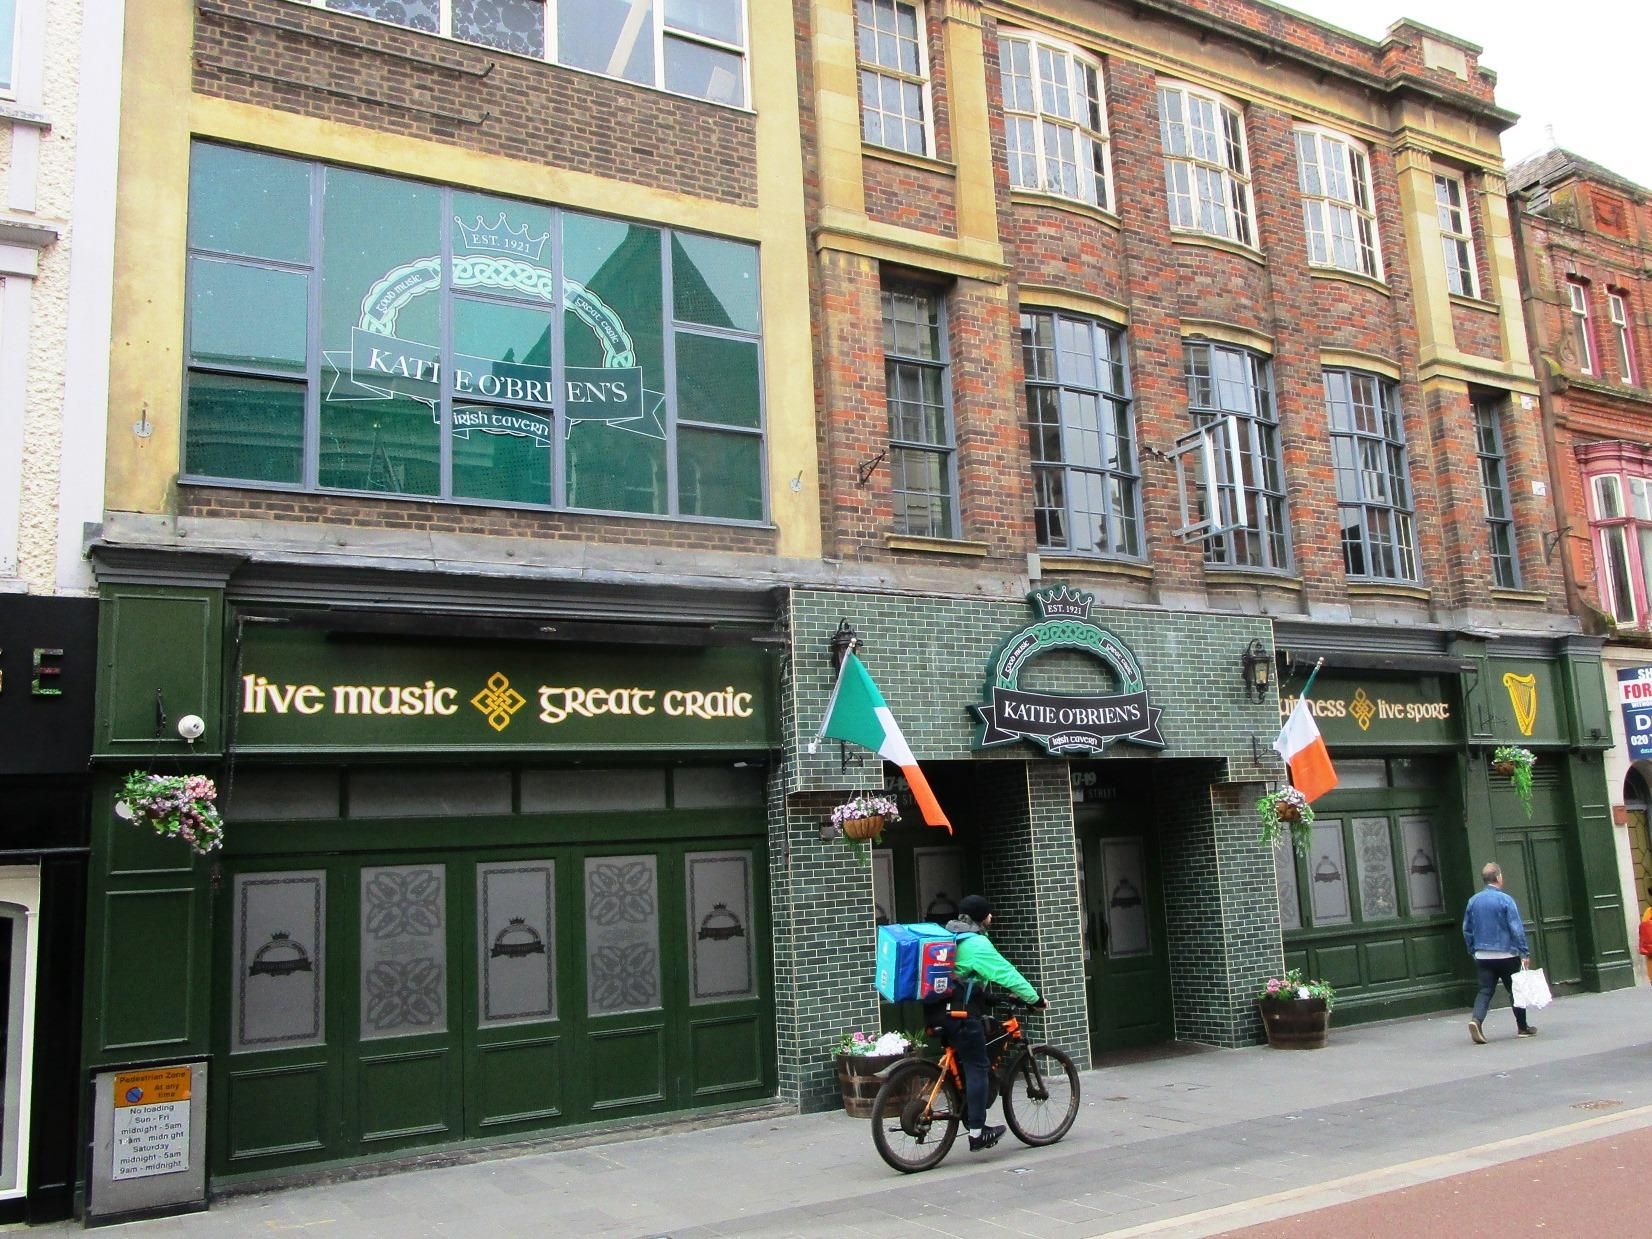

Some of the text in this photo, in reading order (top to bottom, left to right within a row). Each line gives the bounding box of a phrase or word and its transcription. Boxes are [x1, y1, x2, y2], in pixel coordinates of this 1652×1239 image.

[472, 233, 531, 253] EST. 1921
[369, 347, 474, 391] KATIE
[1047, 604, 1082, 614] EST. 1921
[242, 673, 754, 723] live music great craic
[1003, 700, 1142, 726] KATIE O'BRIEN'S
[1378, 698, 1405, 719] live
[1406, 702, 1450, 723] sport
[120, 1073, 163, 1083] Pedestrian
[144, 1105, 174, 1113] loading
[121, 1125, 157, 1135] midnight
[133, 1143, 169, 1152] Saturday
[120, 1155, 156, 1164] midnight
[145, 1161, 181, 1171] midnight
